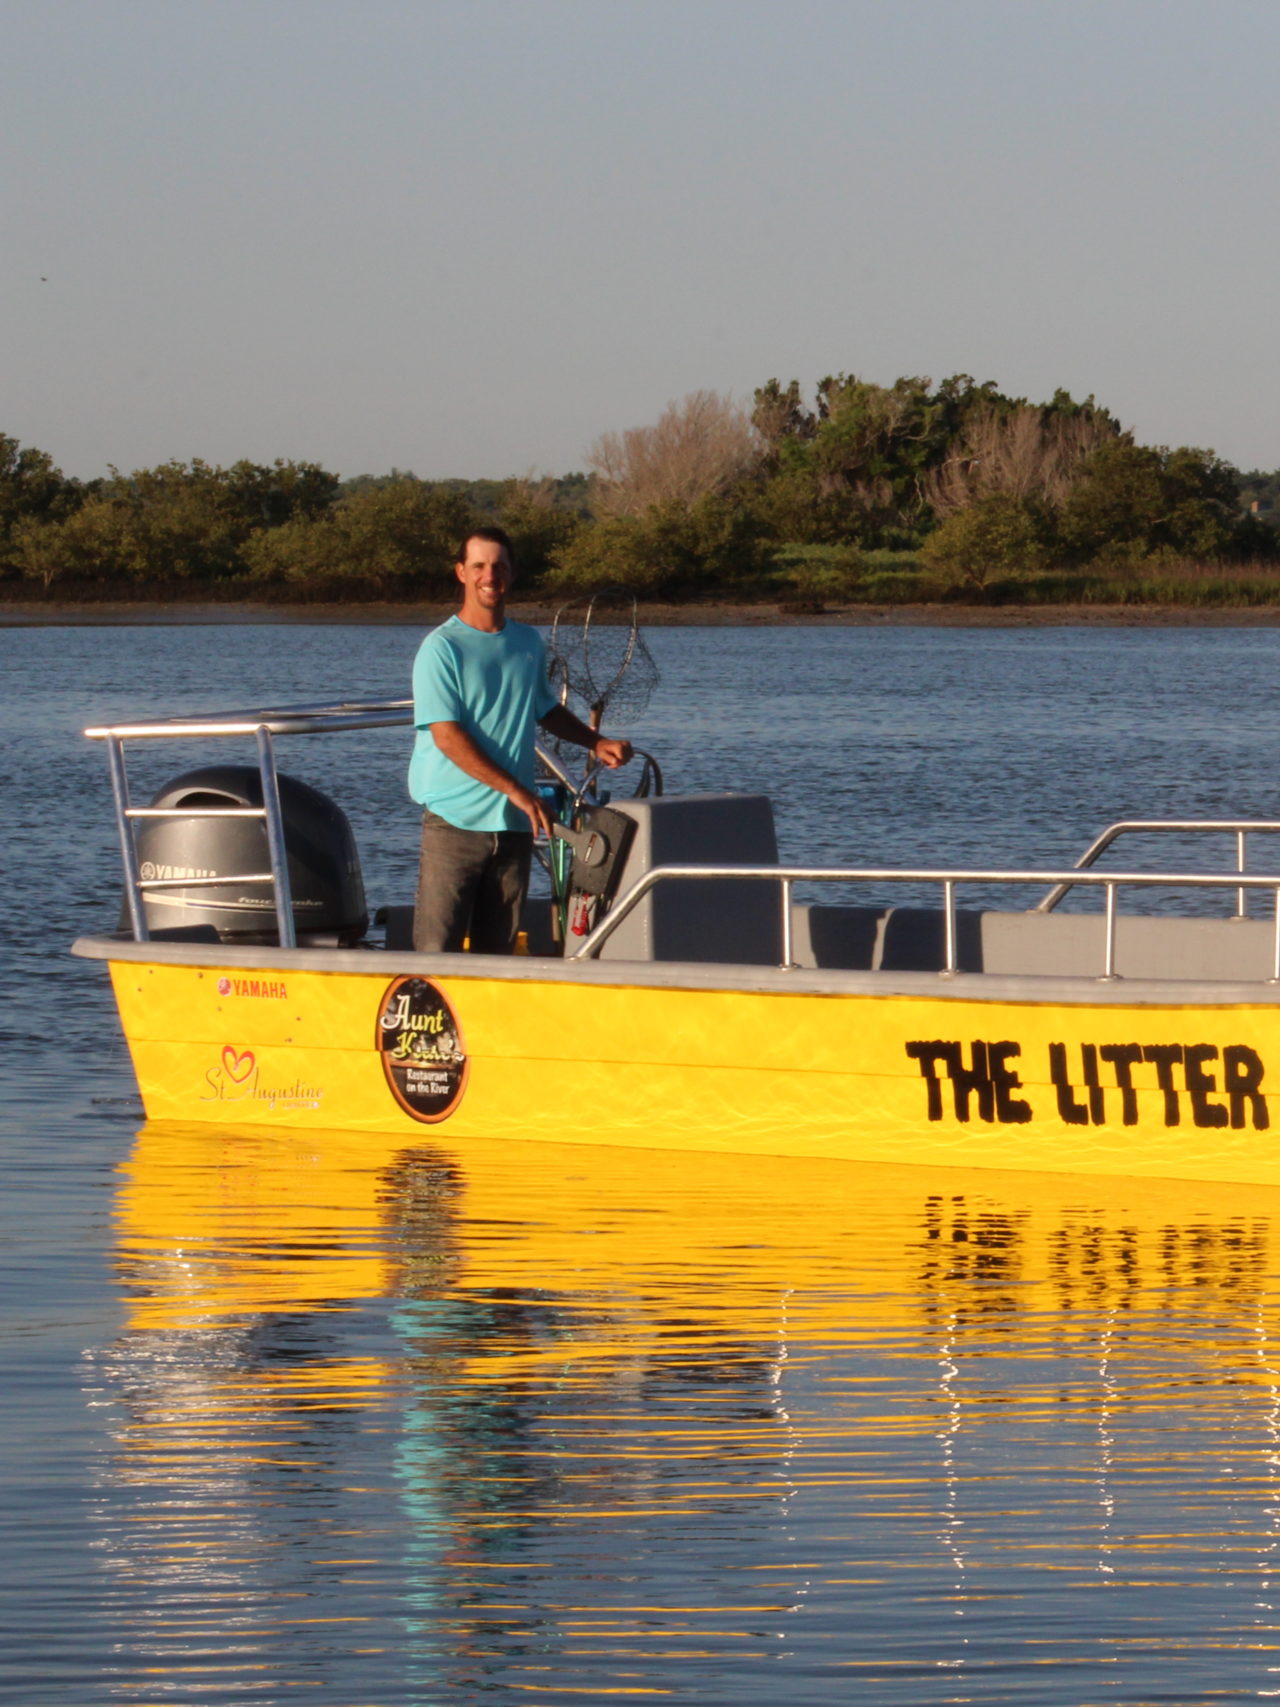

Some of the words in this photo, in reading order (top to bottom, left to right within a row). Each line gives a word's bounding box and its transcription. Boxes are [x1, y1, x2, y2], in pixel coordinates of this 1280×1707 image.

[233, 979, 288, 999] YAMAHA
[380, 994, 444, 1034] Aunt
[228, 1067, 324, 1109] Augustine
[406, 1068, 449, 1082] Restaurant
[406, 1082, 417, 1093] on
[417, 1081, 430, 1093] the
[430, 1081, 450, 1094] River
[905, 1040, 1034, 1125] THE
[1049, 1041, 1270, 1132] LITTER
